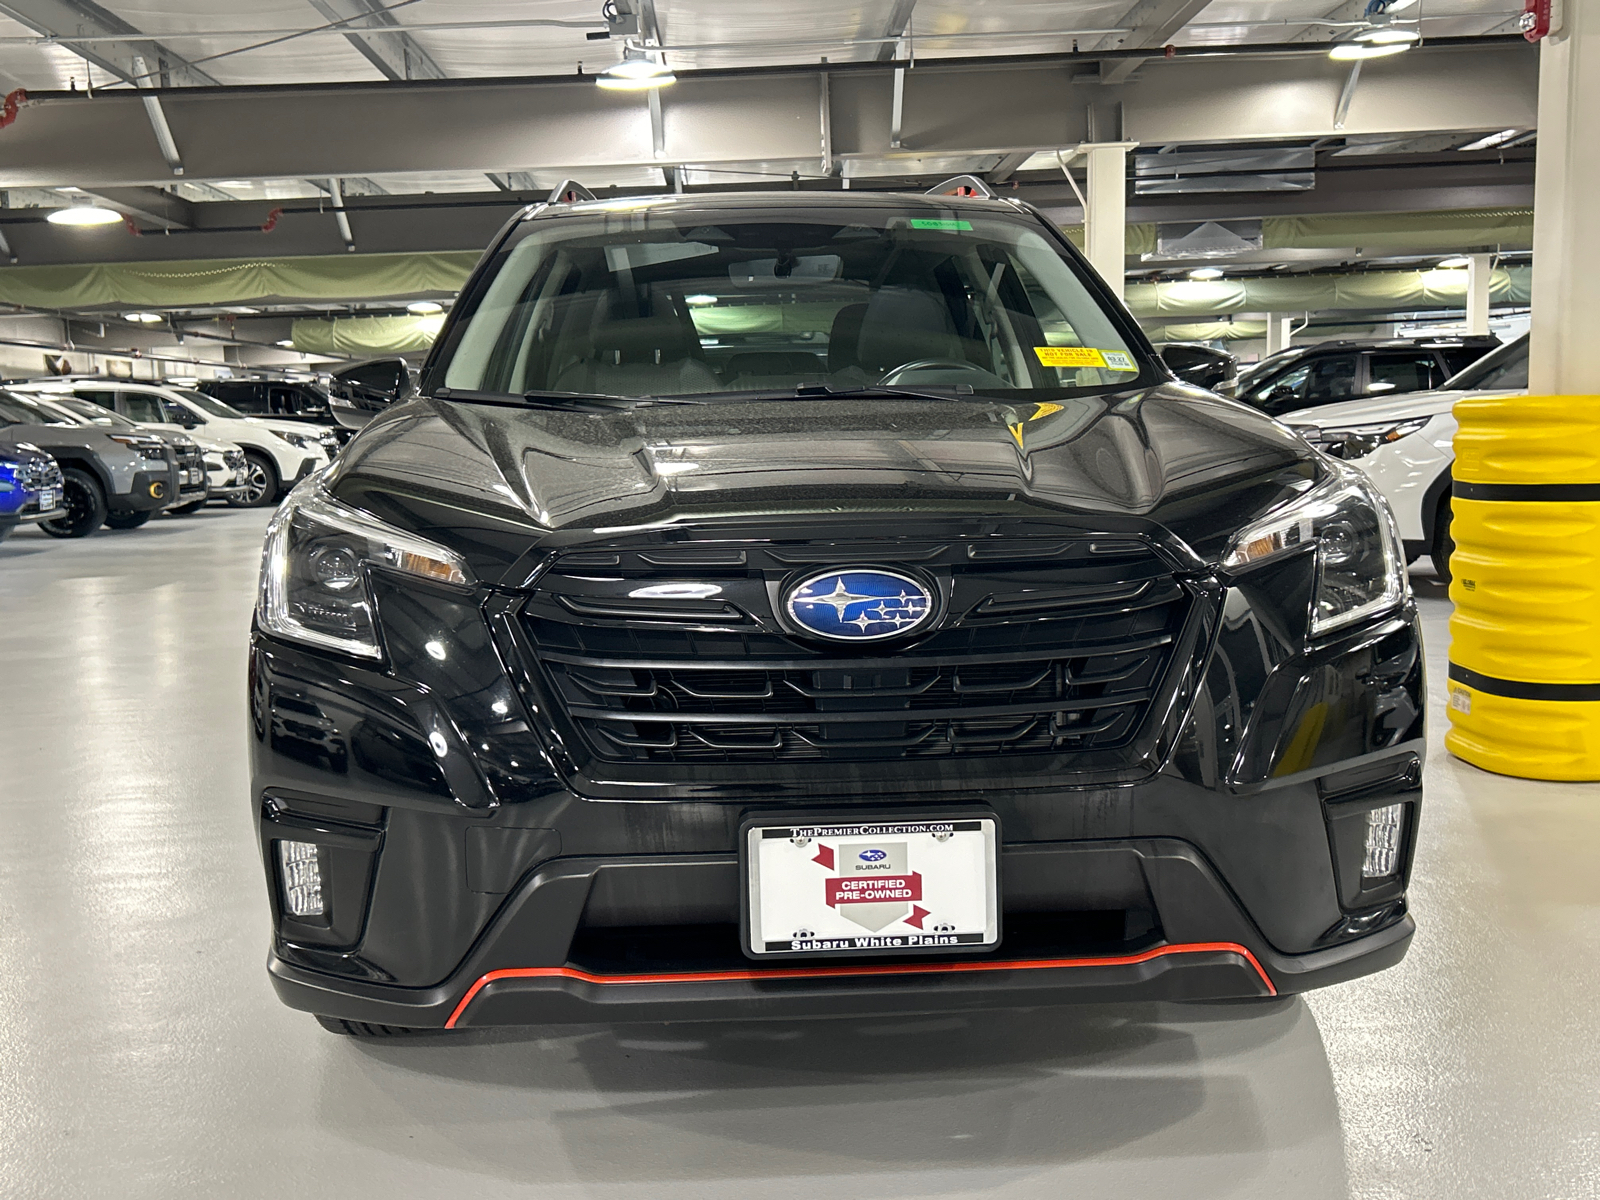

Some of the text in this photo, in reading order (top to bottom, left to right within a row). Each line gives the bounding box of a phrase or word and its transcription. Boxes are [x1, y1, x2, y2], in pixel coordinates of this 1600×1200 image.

[841, 879, 905, 890] CERTIFIED
[836, 889, 912, 900] PRE-OWNED
[791, 935, 958, 950] Subaru White Plains
